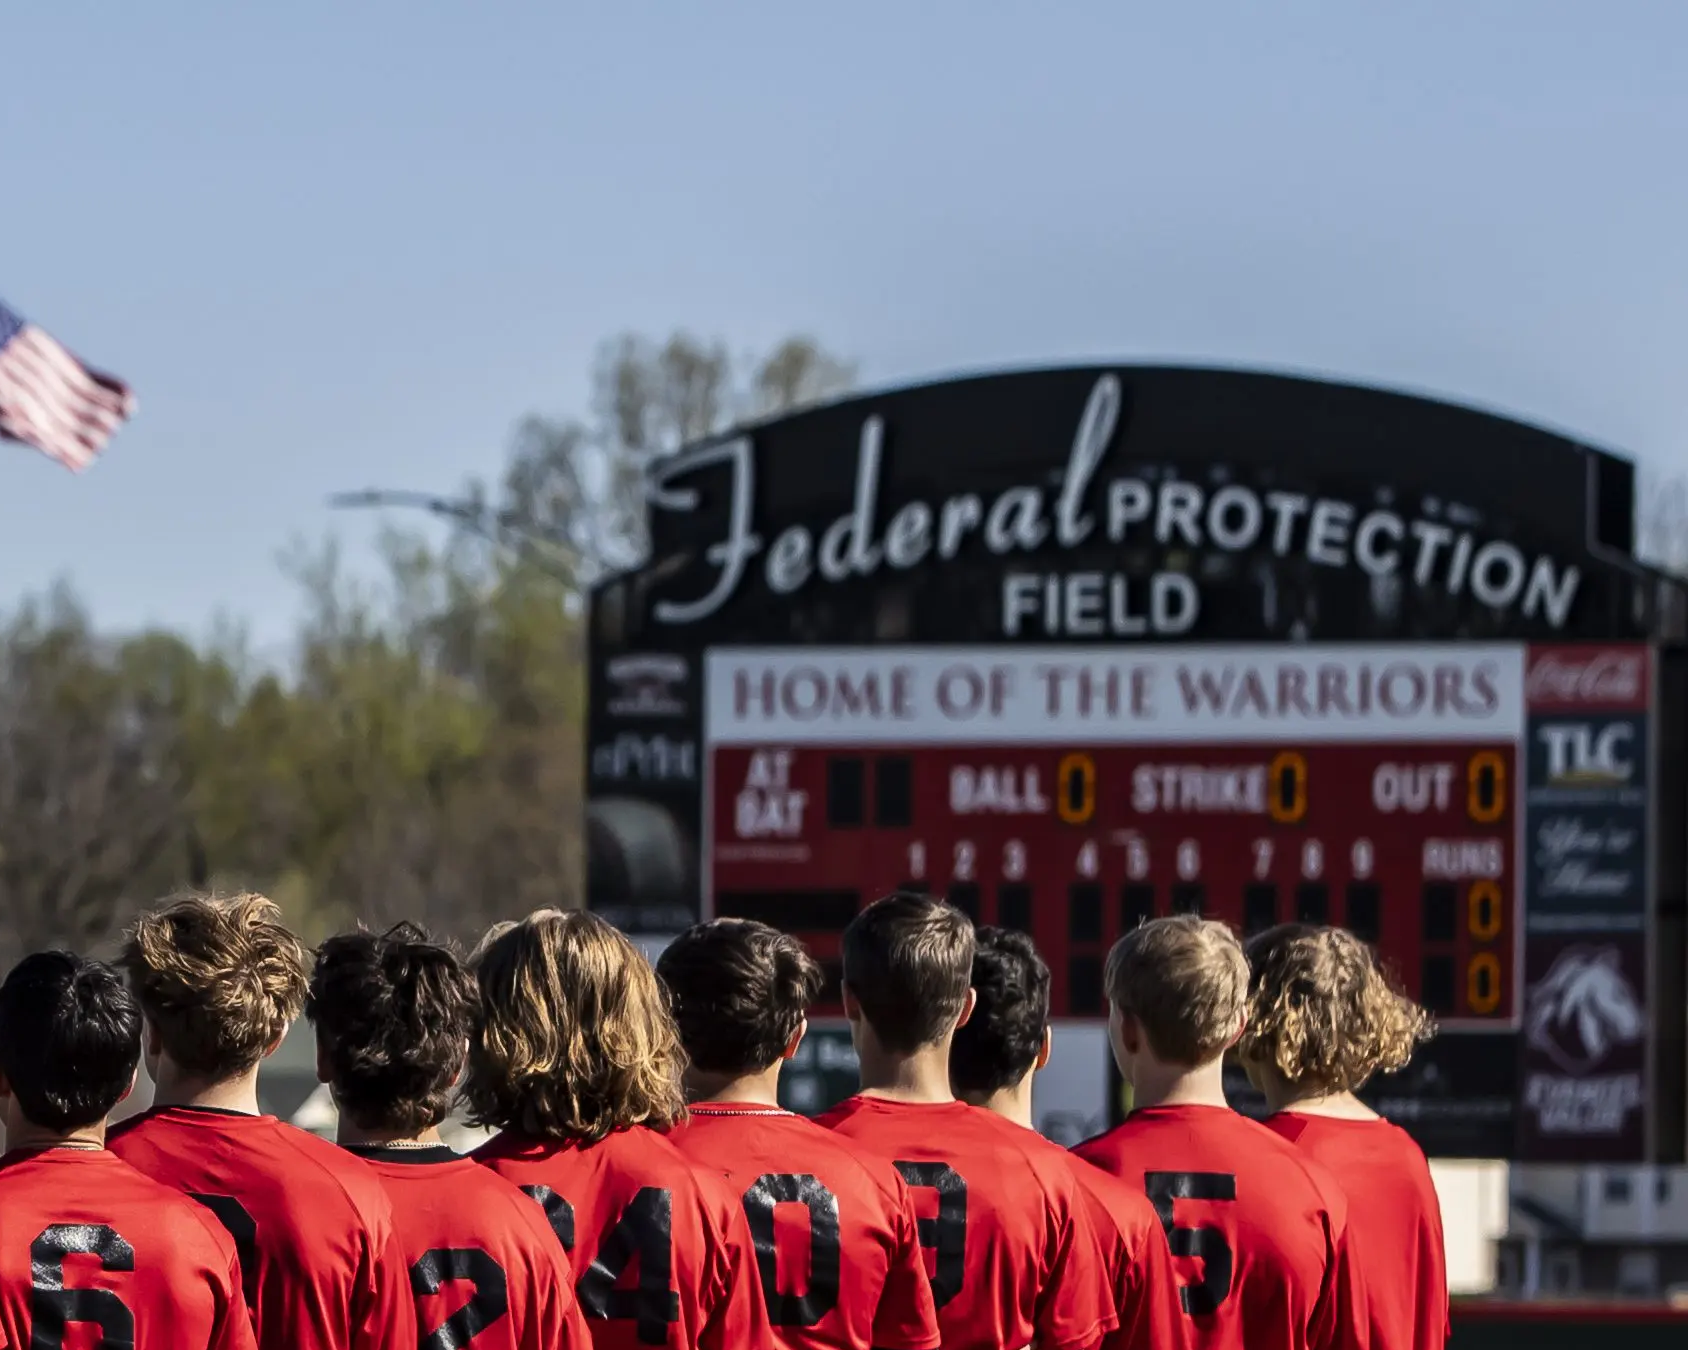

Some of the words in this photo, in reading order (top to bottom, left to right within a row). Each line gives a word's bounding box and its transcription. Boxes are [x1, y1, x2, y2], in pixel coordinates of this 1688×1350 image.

[645, 373, 1121, 624] Federal
[1107, 479, 1580, 628] PROTECTION
[1003, 572, 1200, 636] FIELD
[732, 664, 918, 721] HOME
[935, 664, 1015, 721] OF
[1039, 664, 1156, 721] THE
[1176, 660, 1502, 721] WARRIORS
[747, 749, 796, 790] AT
[1537, 723, 1634, 778] TLC
[734, 790, 808, 837] BAT
[949, 766, 1047, 814] BALL
[1058, 752, 1095, 824] 0
[1131, 763, 1269, 814] STRIKE
[1269, 751, 1308, 824] 0
[1372, 762, 1454, 814] OUT
[1468, 750, 1506, 824] 0
[953, 839, 977, 880] 2
[1075, 839, 1099, 880] 4
[1253, 838, 1274, 880] 7
[1422, 838, 1504, 880] RUNS
[1468, 881, 1502, 940] 0
[1468, 952, 1502, 1013] 0
[519, 1184, 680, 1346] 4
[742, 1173, 841, 1326] 0
[1144, 1171, 1236, 1315] 5
